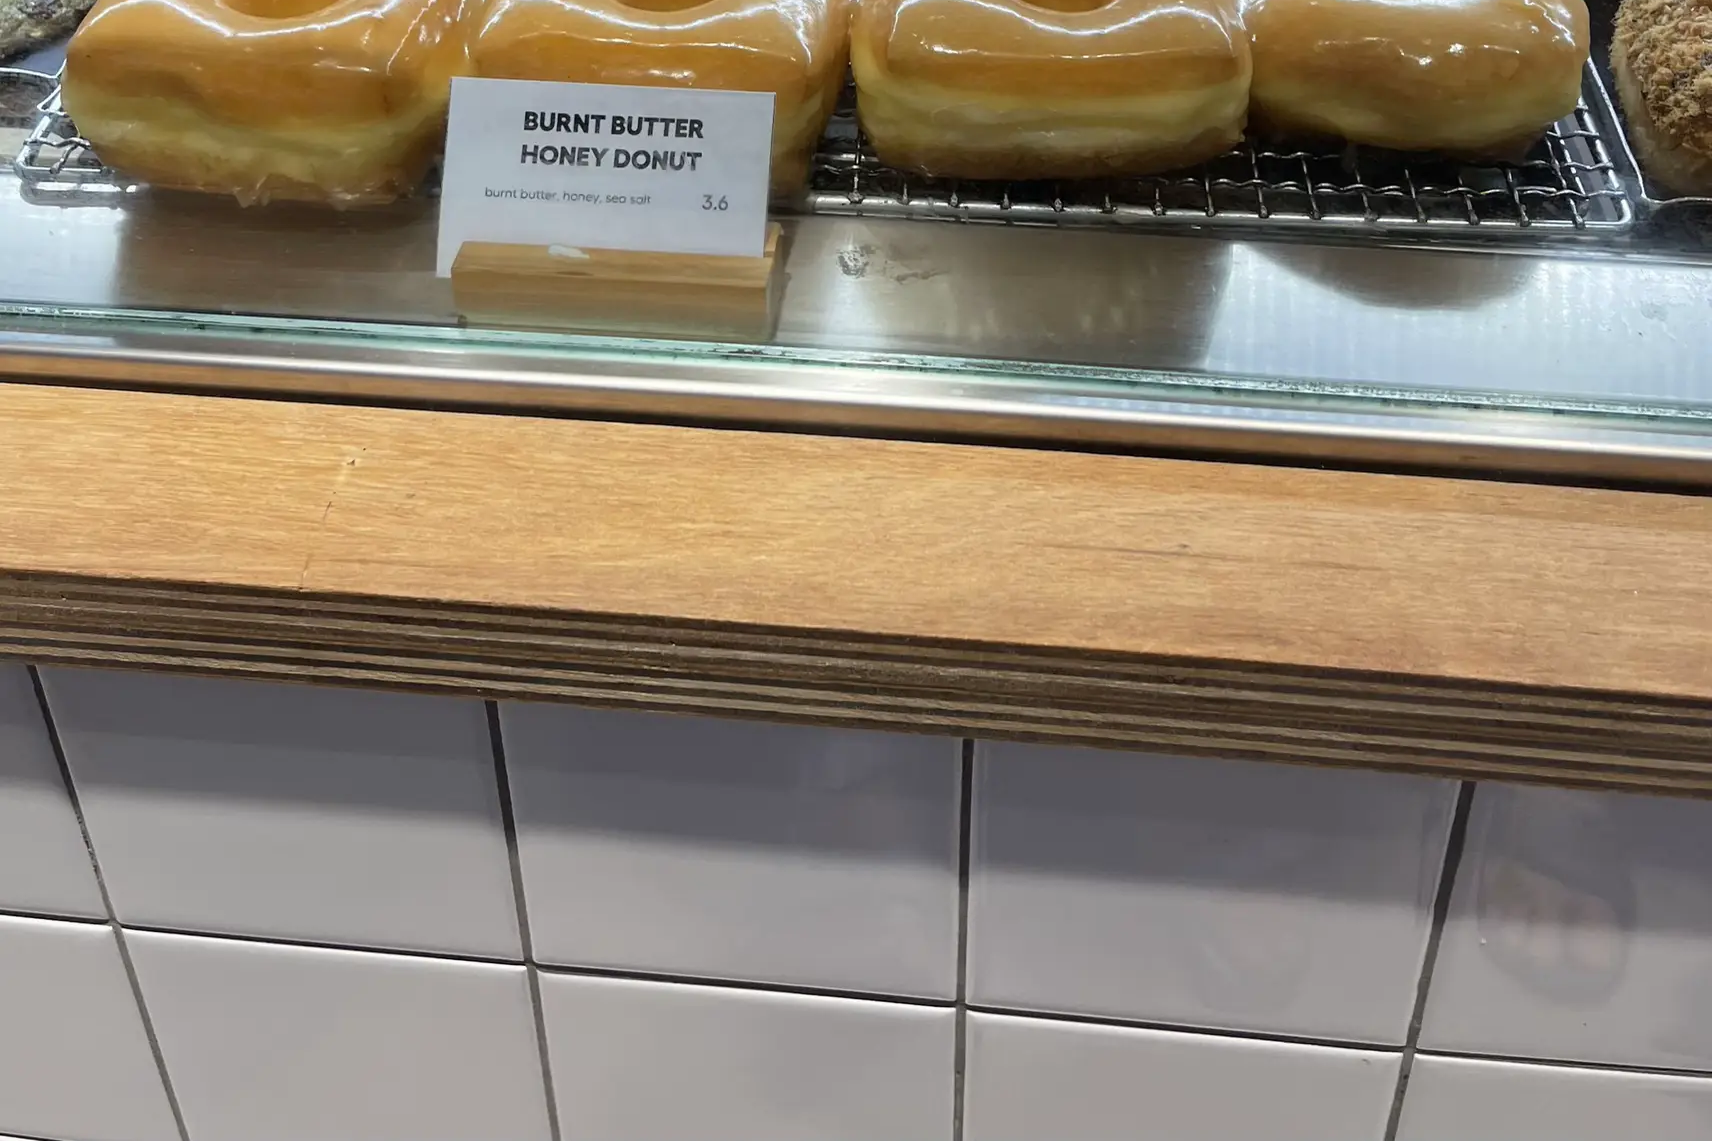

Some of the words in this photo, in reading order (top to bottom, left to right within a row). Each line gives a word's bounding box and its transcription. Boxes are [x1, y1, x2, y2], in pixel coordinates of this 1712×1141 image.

[523, 110, 606, 135] BURNT
[611, 115, 704, 139] BUTTER
[520, 144, 610, 168] HONEY
[613, 148, 703, 172] DONUT
[484, 187, 517, 200] burnt
[520, 188, 559, 203] butter,
[562, 190, 603, 205] honey,
[605, 194, 627, 205] sea
[630, 194, 651, 205] salt
[702, 194, 729, 212] 3.6
